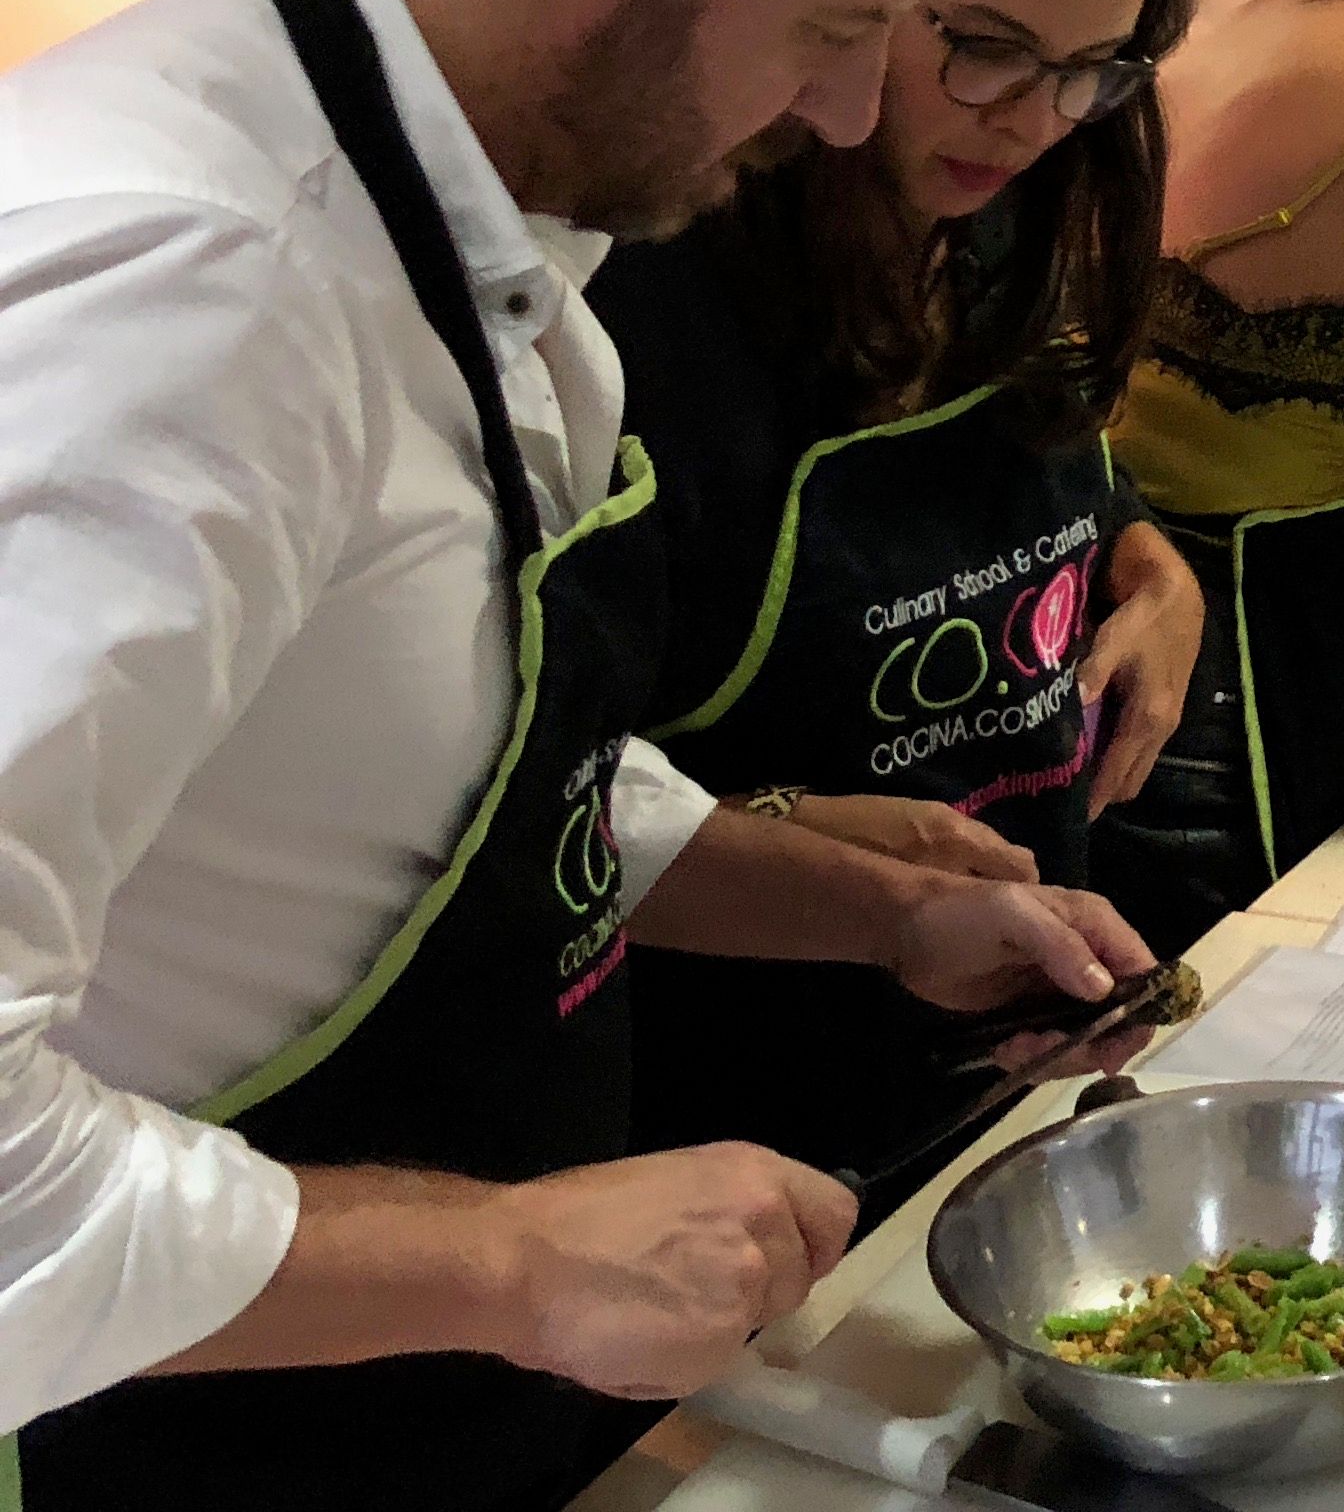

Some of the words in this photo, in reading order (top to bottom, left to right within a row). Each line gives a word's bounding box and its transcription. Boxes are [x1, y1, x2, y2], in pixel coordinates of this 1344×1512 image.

[864, 585, 948, 636] Culinary
[952, 554, 1011, 603] School
[1012, 547, 1032, 574] &
